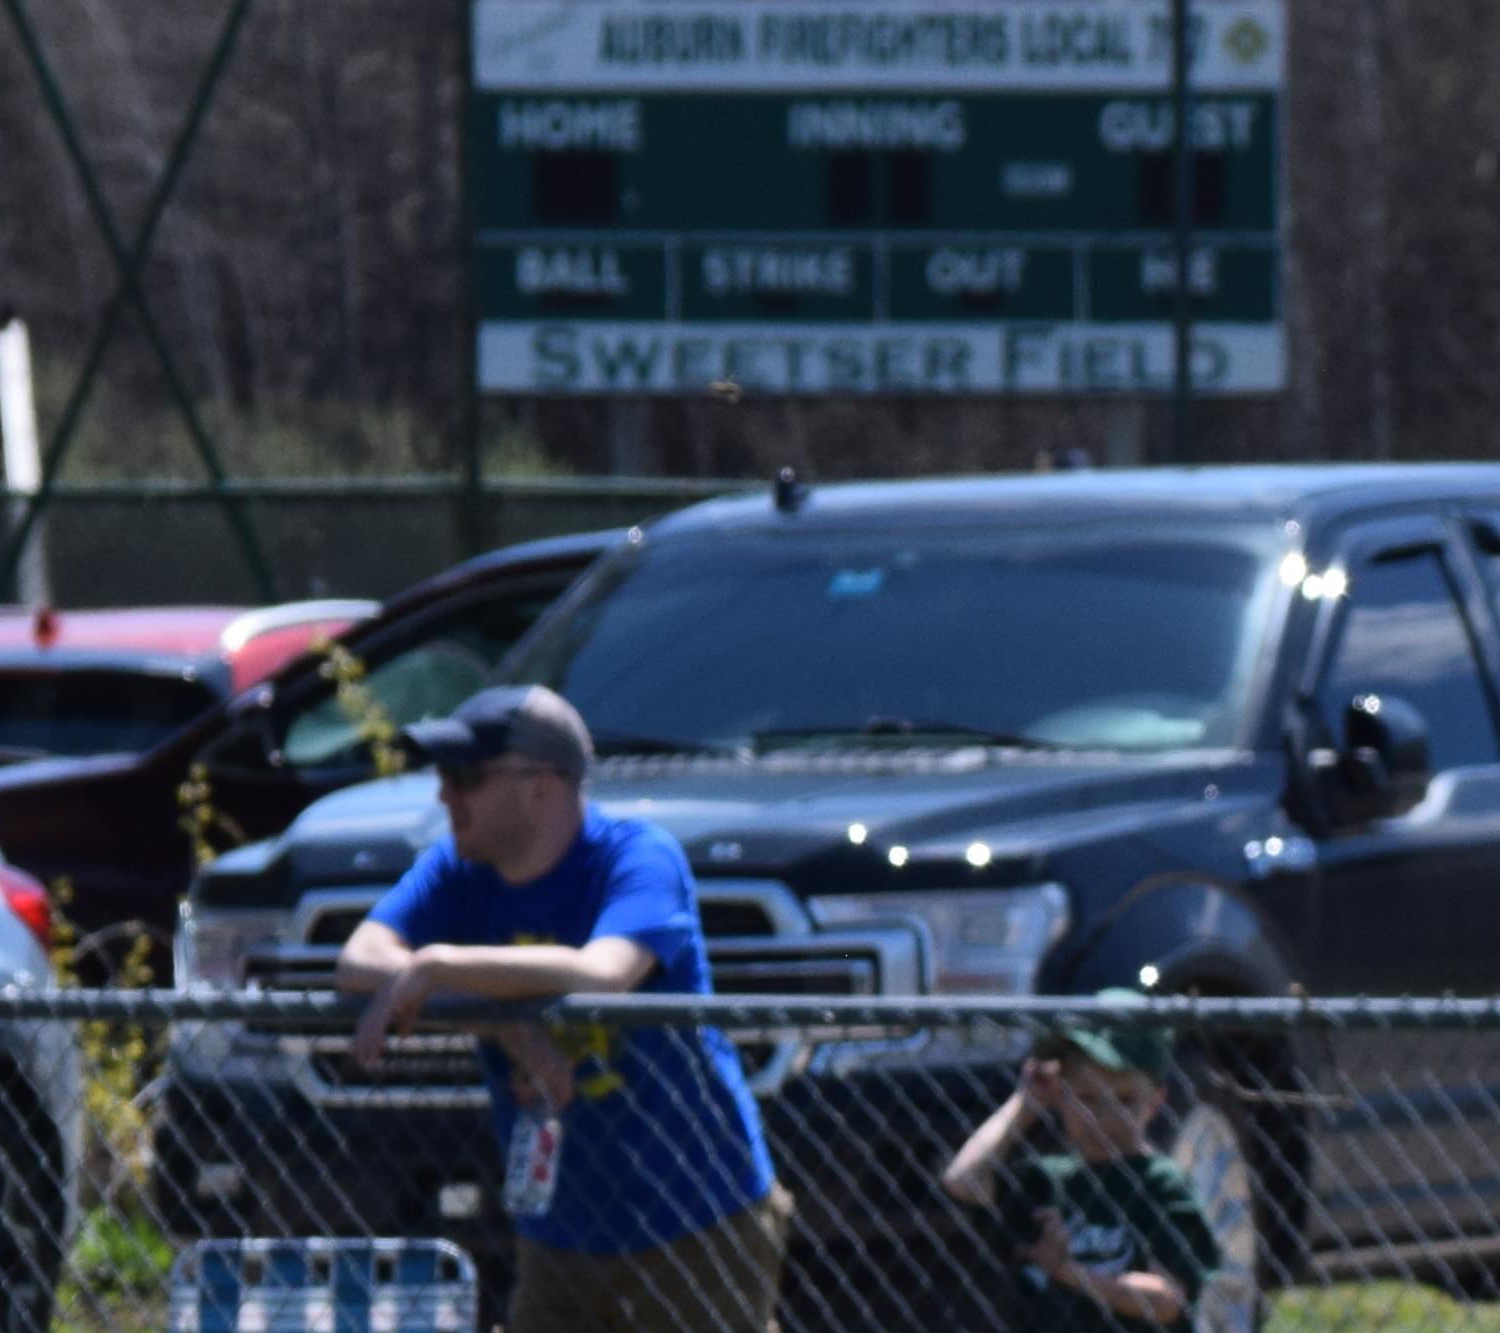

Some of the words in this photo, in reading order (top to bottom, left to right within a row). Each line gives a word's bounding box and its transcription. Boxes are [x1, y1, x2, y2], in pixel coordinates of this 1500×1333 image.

[599, 13, 744, 65] AUBURN
[757, 13, 1008, 65] FIREFIGHTERS
[1022, 13, 1132, 65] LOCAL
[499, 101, 642, 151] HOME
[789, 101, 965, 151] INNING
[1100, 101, 1258, 151] GUST
[516, 247, 628, 295] BALL
[703, 247, 853, 295] STRIKE
[926, 248, 1027, 296] OUT
[532, 324, 972, 390] SWEETSER
[1004, 322, 1231, 390] FIELD
